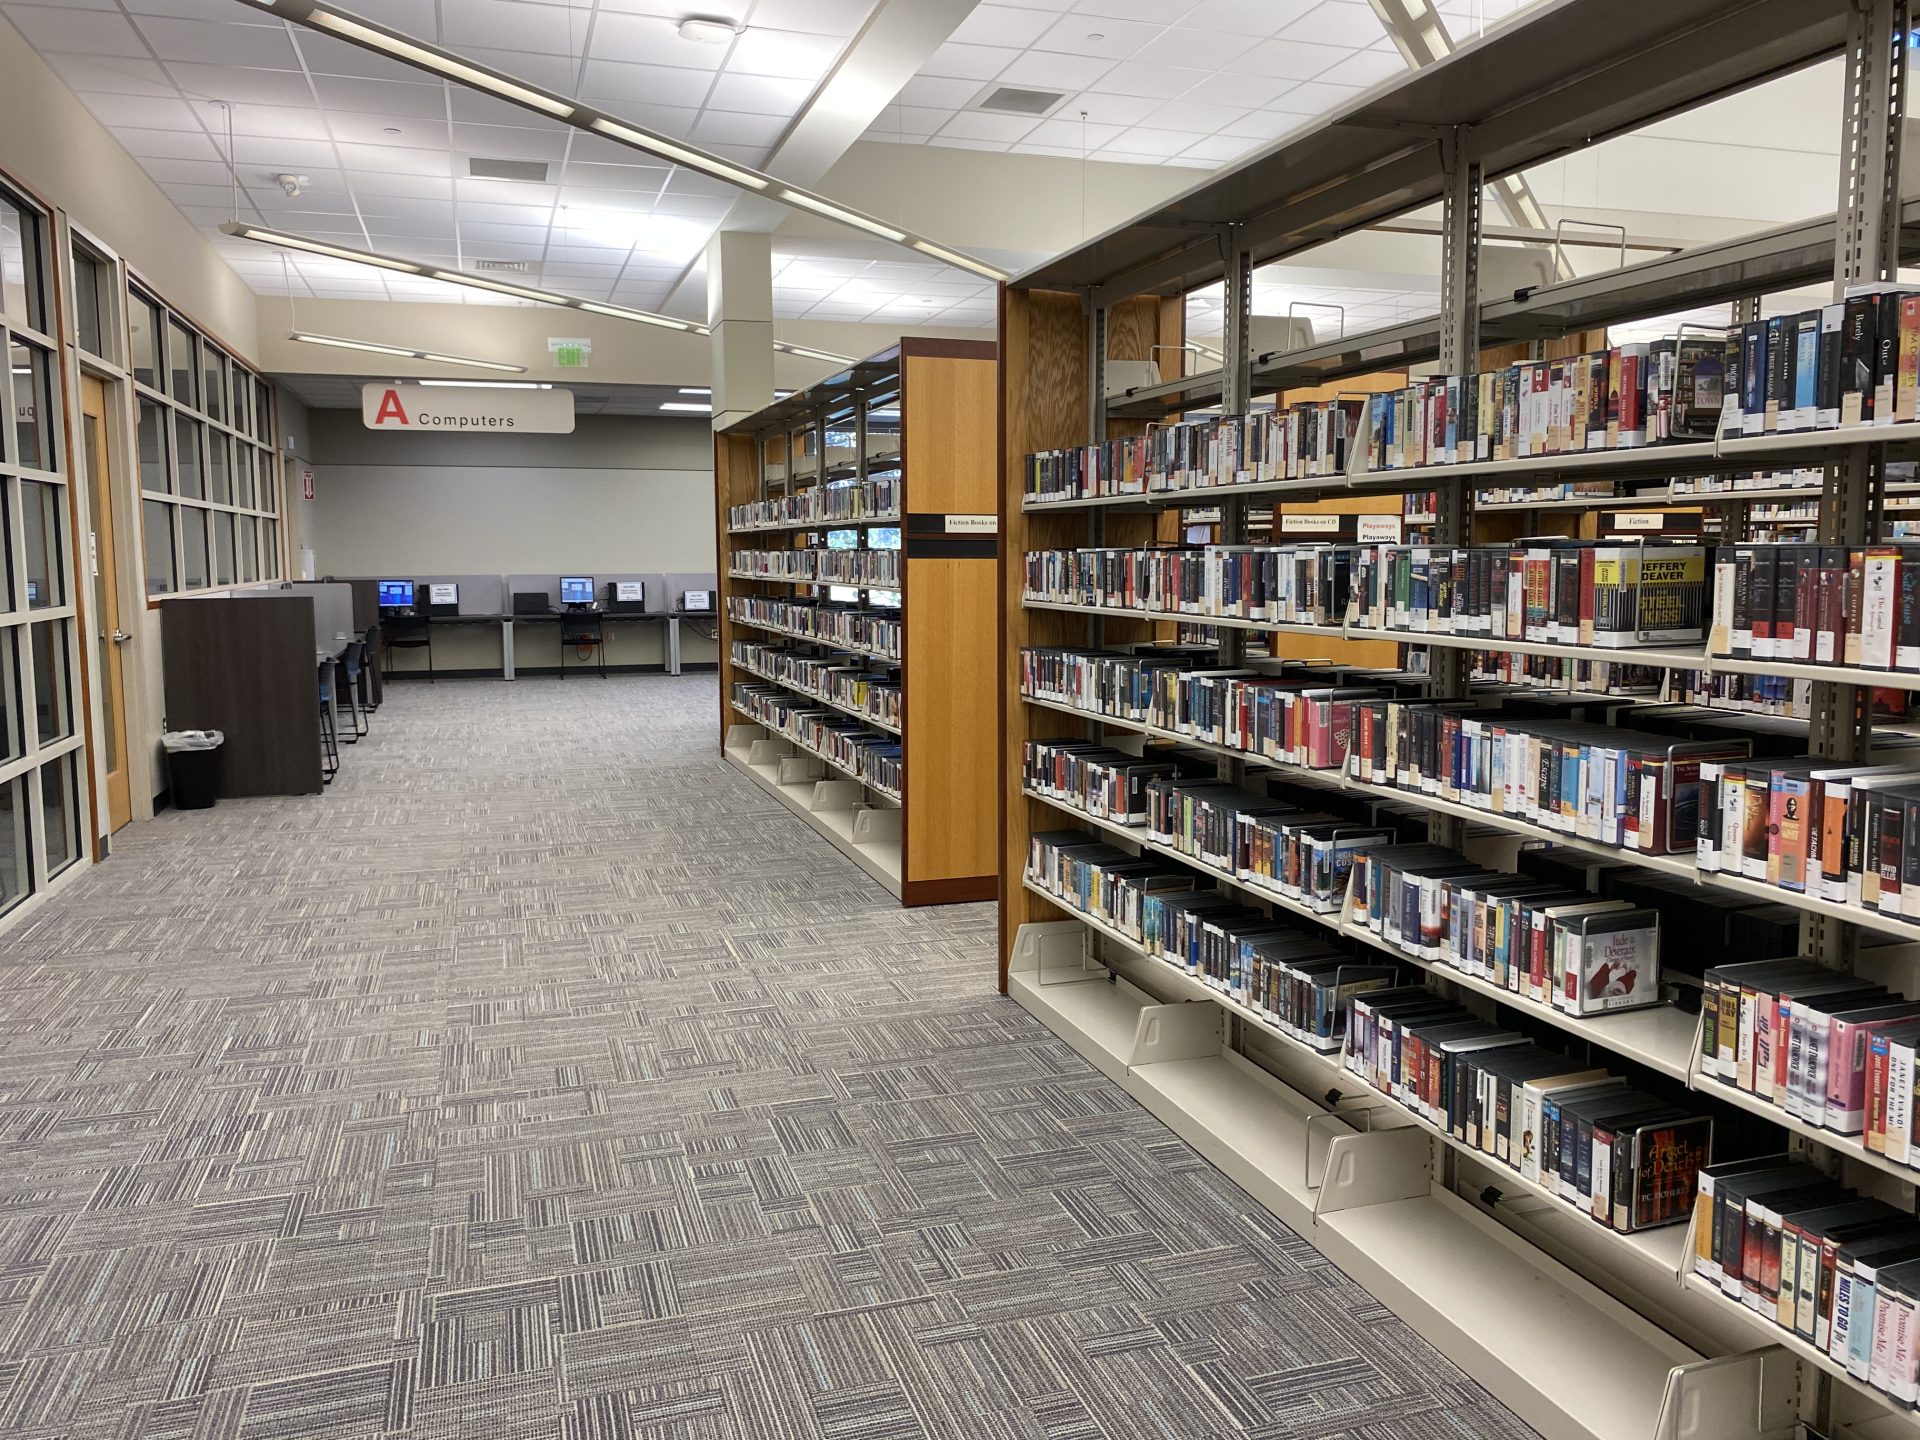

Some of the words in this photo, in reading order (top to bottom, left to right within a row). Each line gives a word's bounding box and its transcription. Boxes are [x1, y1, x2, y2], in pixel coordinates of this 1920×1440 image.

[1855, 314, 1865, 342] Barely
[1881, 339, 1892, 361] Out
[375, 389, 410, 425] A
[418, 412, 516, 429] Computers
[1362, 523, 1396, 531] Playaways
[1629, 517, 1649, 525] Fiction
[1641, 571, 1684, 581] DEAVER
[1850, 593, 1858, 623] COPPER
[1538, 757, 1550, 790] Escape
[1871, 813, 1880, 839] Requiem
[1809, 827, 1818, 861] DETACHM
[1897, 1060, 1906, 1091] JANET
[1887, 1096, 1895, 1112] THE
[1896, 1095, 1905, 1129] EVANO
[1838, 1276, 1852, 1306] MILES
[1836, 1315, 1848, 1331] GO
[1878, 1299, 1890, 1337] Promise
[1897, 1307, 1910, 1345] Promise
[1875, 1336, 1887, 1353] Me
[1895, 1344, 1907, 1362] Me
